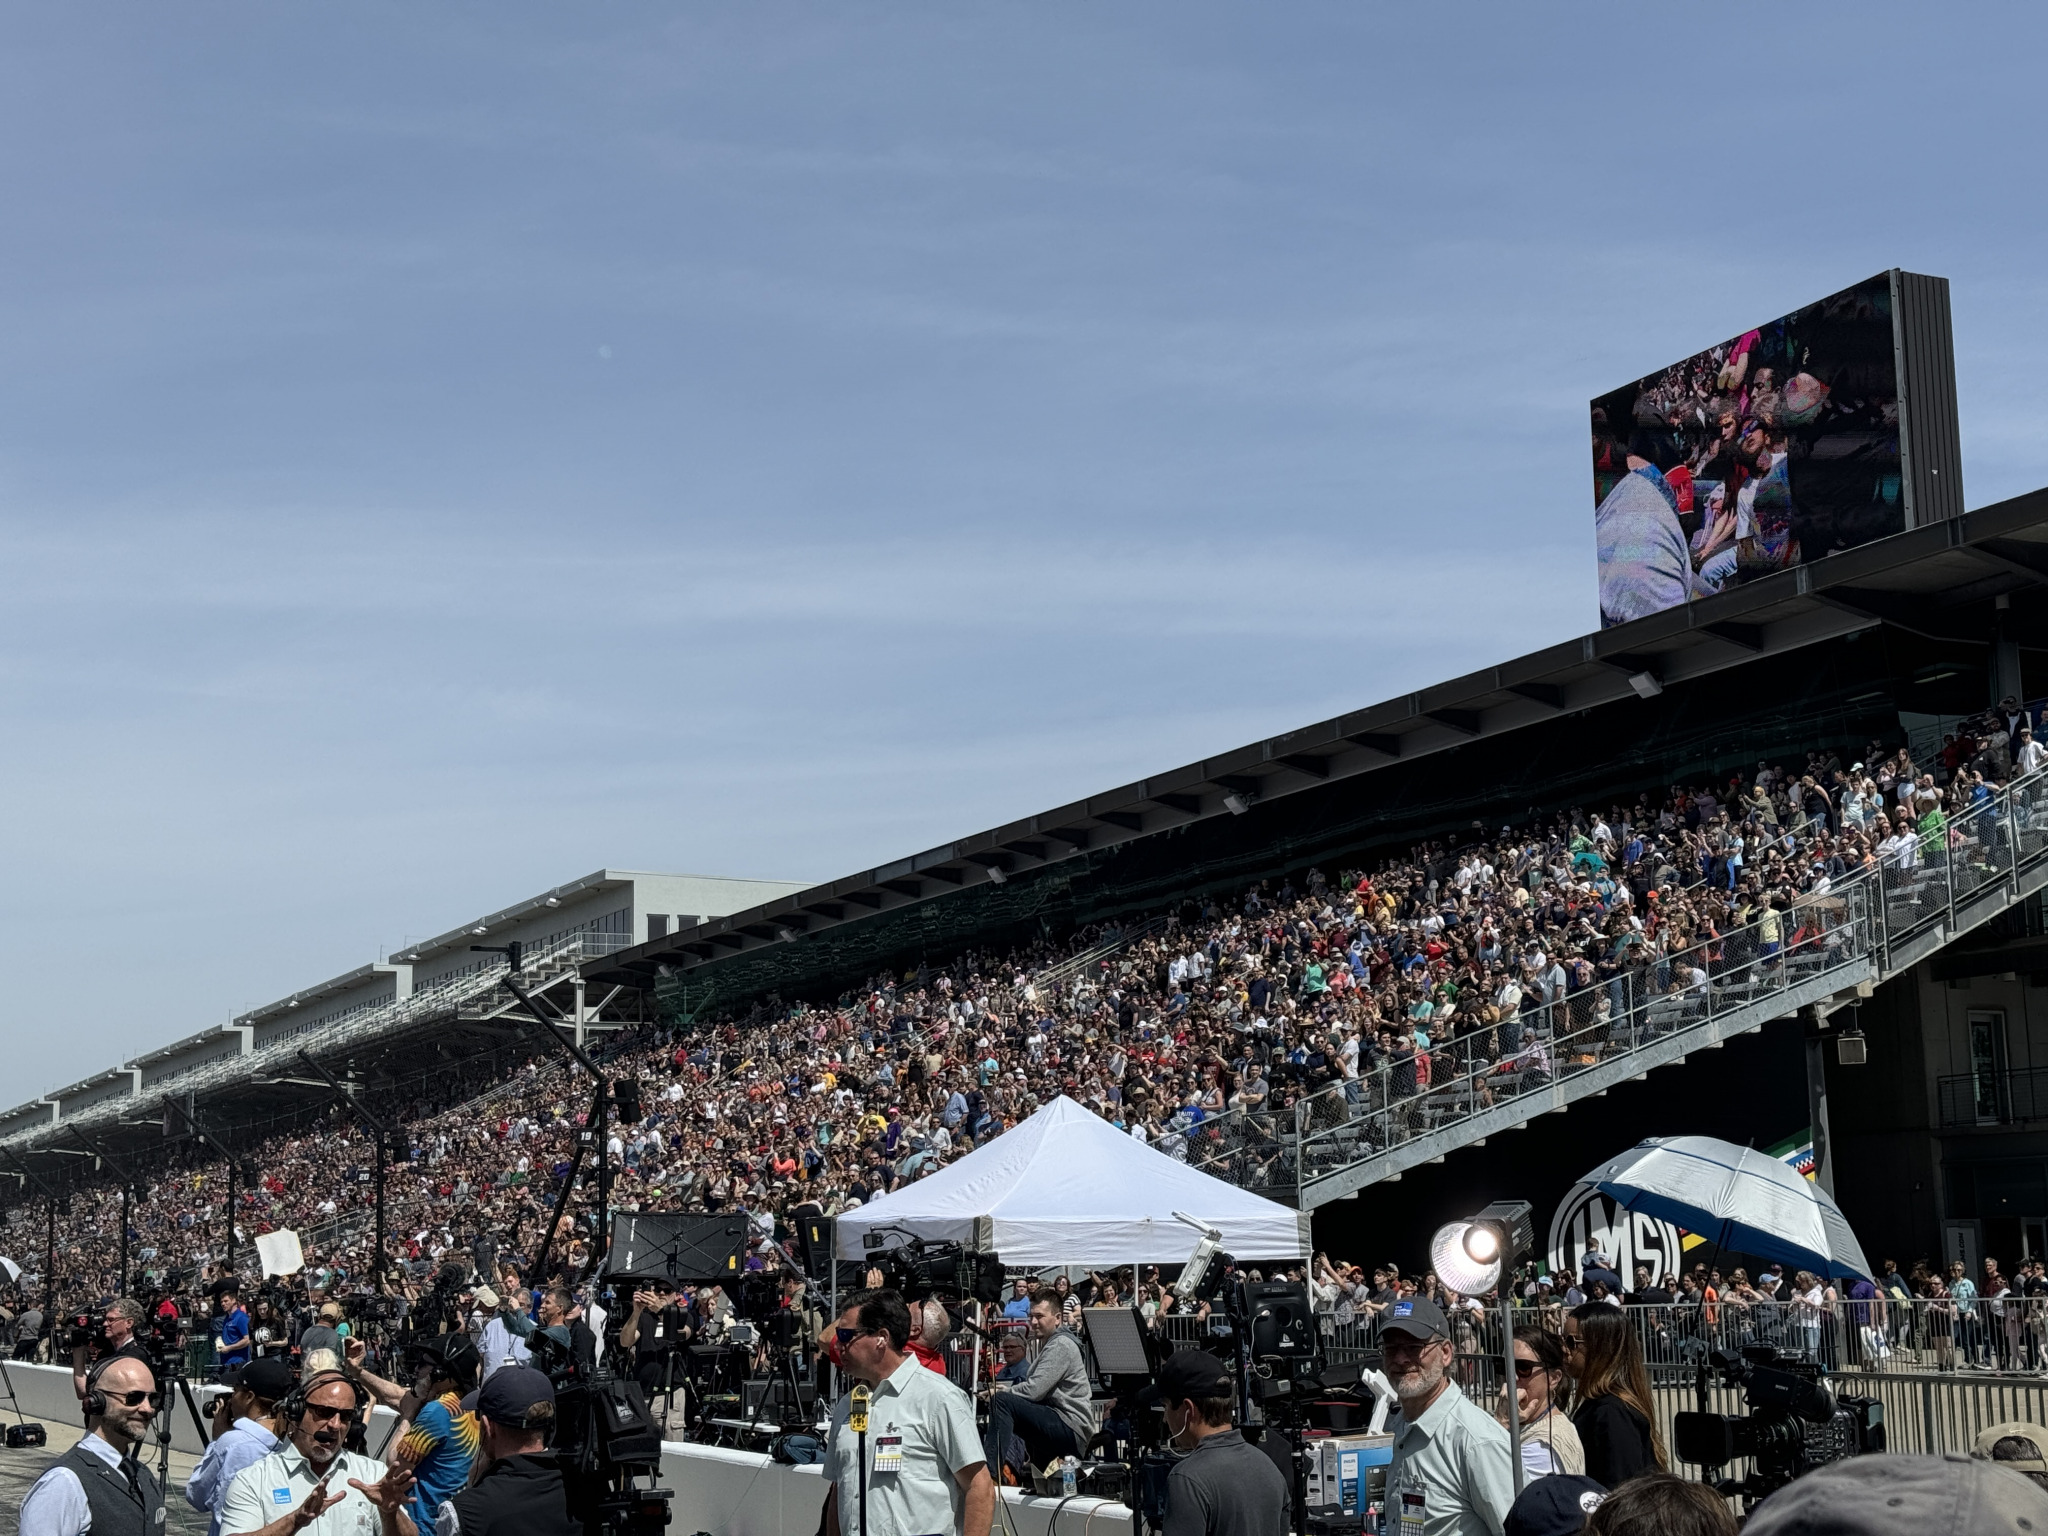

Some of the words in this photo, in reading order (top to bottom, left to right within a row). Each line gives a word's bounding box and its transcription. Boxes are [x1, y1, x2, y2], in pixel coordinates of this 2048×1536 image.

[581, 1131, 592, 1141] 19
[359, 1173, 370, 1181] 20
[1573, 1197, 1662, 1294] IMS
